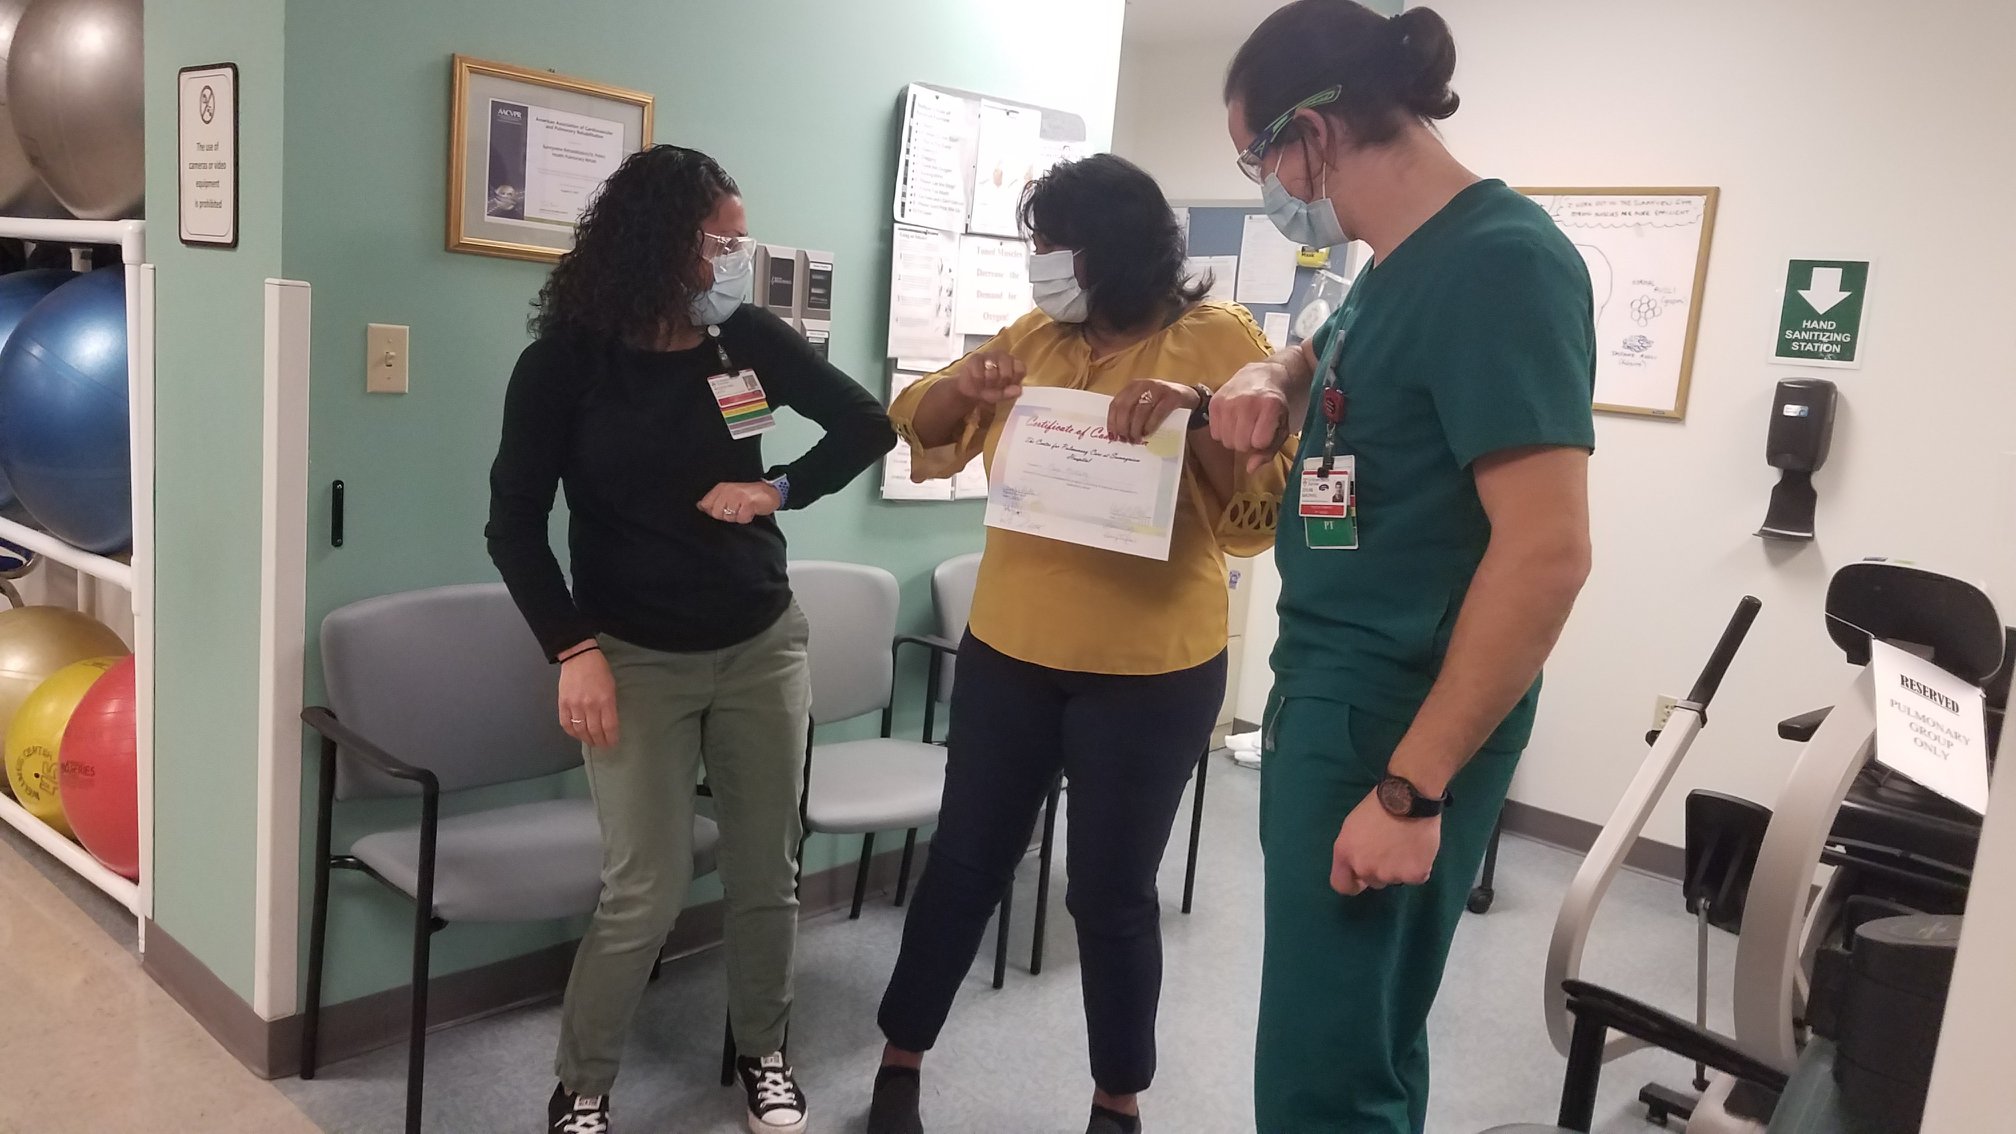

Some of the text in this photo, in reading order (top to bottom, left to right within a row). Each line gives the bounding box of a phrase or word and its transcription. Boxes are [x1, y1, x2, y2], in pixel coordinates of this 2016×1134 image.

[497, 108, 522, 119] AACVPR
[535, 116, 555, 124] American
[556, 120, 579, 129] Association
[585, 126, 614, 136] Cardiovascular
[554, 126, 576, 135] Pulmonary
[577, 130, 604, 139] Rehabilitation
[196, 142, 205, 151] The
[214, 141, 219, 151] of
[188, 162, 208, 170] cameras
[214, 161, 227, 170] video
[195, 180, 219, 190] equipment
[199, 199, 222, 210] prohibited
[998, 247, 1023, 257] Muscles
[977, 268, 1019, 279] Decrease the
[976, 290, 1017, 300] Demand for
[1802, 319, 1837, 330] HAND
[1785, 329, 1851, 343] SANITIZING
[1791, 341, 1841, 354] STATION
[1026, 415, 1074, 434] Certificate
[1075, 426, 1091, 440] of
[1062, 444, 1088, 456] Pulmonary
[1066, 454, 1093, 463] Hospital
[1323, 521, 1335, 530] PT
[1900, 674, 1960, 716] RESERVED
[1890, 698, 1970, 746] PULMONARY
[1909, 721, 1954, 749] GROUP
[23, 745, 52, 761] CENTER
[1914, 736, 1950, 761] ONLY
